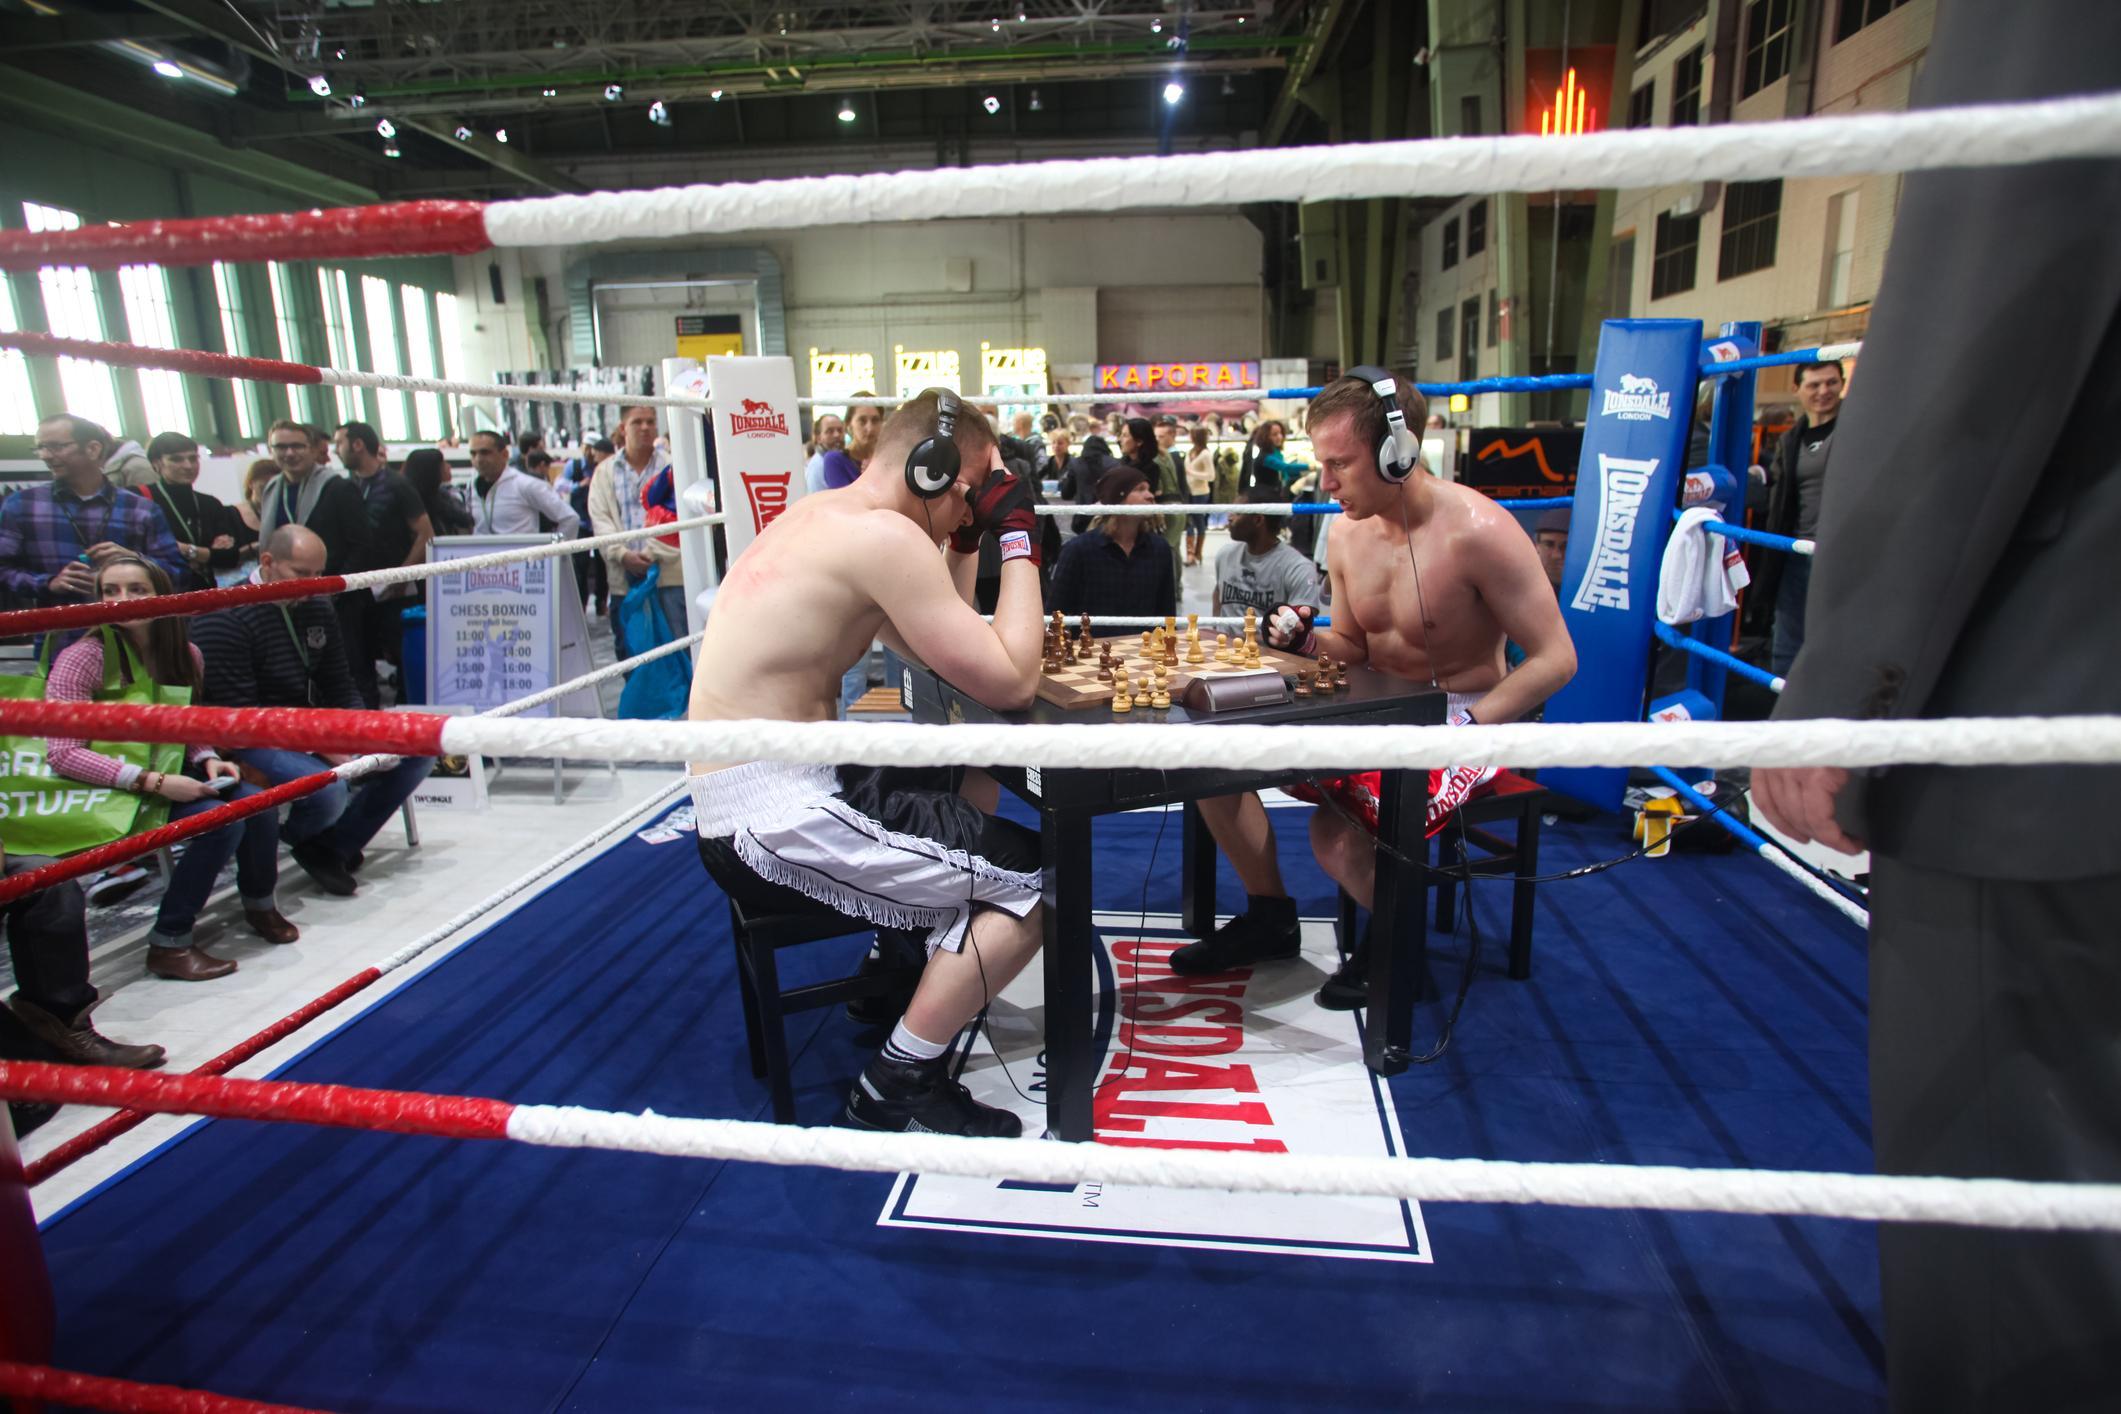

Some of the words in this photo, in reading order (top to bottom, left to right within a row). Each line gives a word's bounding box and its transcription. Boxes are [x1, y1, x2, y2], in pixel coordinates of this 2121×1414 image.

[1102, 364, 1256, 388] KAPORAL
[1601, 390, 1671, 419] LONSDALE
[1617, 412, 1651, 421] LONDON
[729, 413, 789, 436] LONSDALE
[747, 431, 776, 439] LONDON
[1571, 453, 1660, 611] LONSDALE
[1222, 581, 1275, 609] LONSDALE
[450, 604, 489, 617] CHESS
[492, 604, 537, 617] BOXING
[456, 631, 485, 641] 11:00
[502, 631, 532, 641] 12:00
[456, 647, 485, 657] 13:00
[502, 647, 532, 657] 14:00
[456, 663, 485, 673] 15:00
[502, 663, 532, 673] 16:00
[502, 679, 532, 689] 18:00
[1426, 766, 1487, 823] ONSDA
